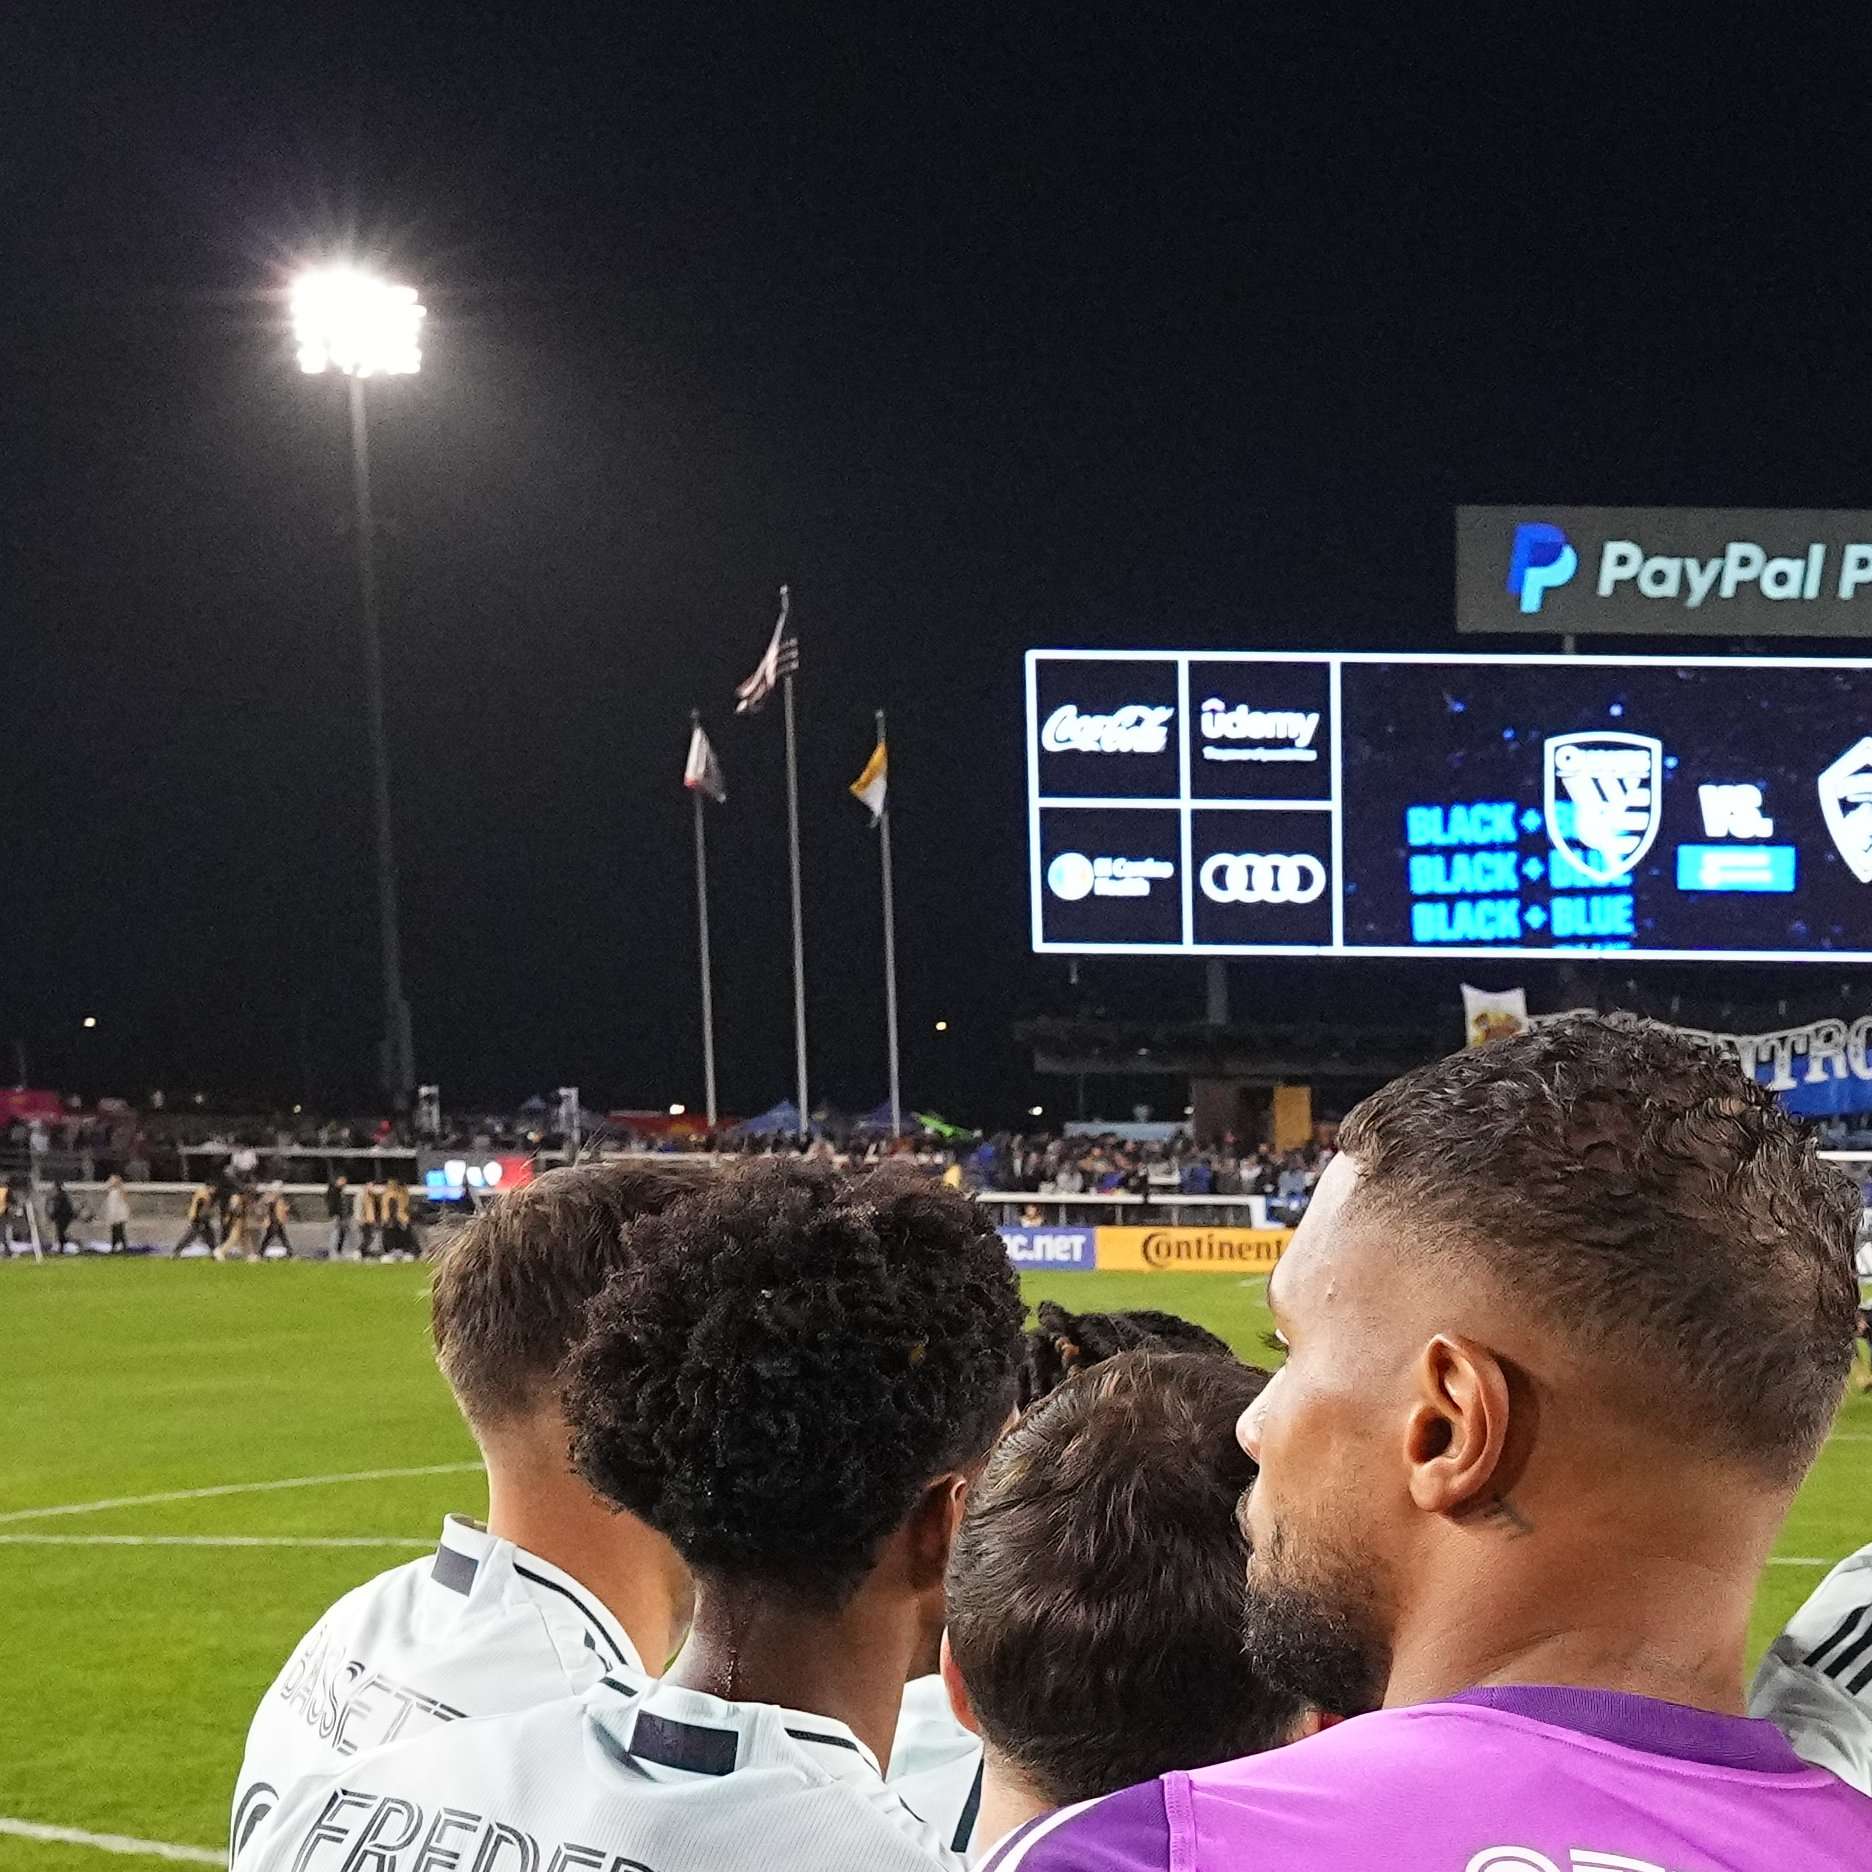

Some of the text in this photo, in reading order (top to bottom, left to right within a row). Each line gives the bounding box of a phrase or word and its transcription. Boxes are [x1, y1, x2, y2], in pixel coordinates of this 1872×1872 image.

[1597, 540, 1826, 608] PayPal
[1406, 802, 1517, 847] BLACK
[1408, 850, 1519, 895] BLACK
[1411, 898, 1521, 943] BLACK
[1551, 894, 1635, 937] BLUE
